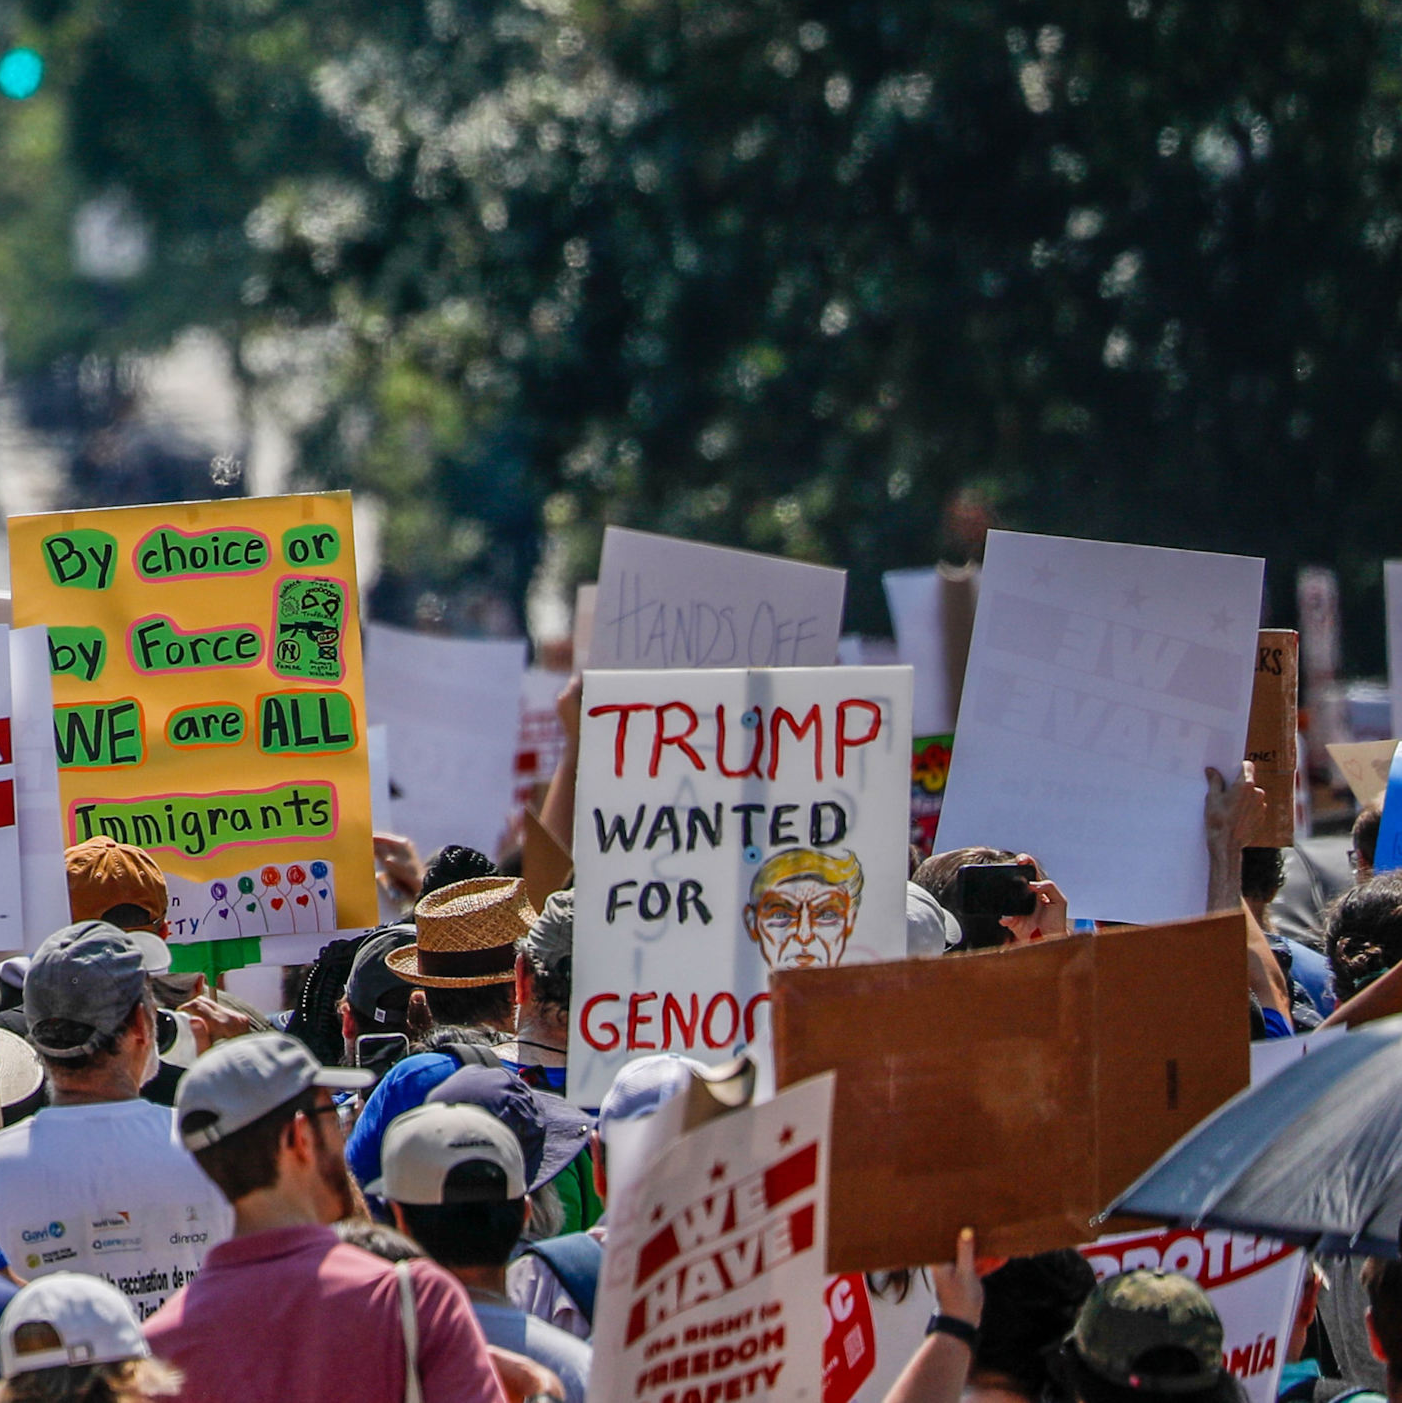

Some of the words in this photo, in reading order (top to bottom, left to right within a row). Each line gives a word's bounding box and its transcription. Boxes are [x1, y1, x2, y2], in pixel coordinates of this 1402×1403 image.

[46, 537, 112, 589] By
[142, 533, 263, 581] choice
[289, 533, 334, 563] or
[607, 570, 736, 667] HANDS
[749, 602, 816, 667] OFF
[47, 633, 101, 681] by
[138, 622, 256, 669] Force
[1255, 648, 1282, 675] RS
[54, 703, 136, 764] WE
[174, 712, 240, 741] are
[263, 698, 349, 748] ALL
[588, 698, 881, 782] TRUMP
[75, 790, 328, 854] Immigrants
[594, 801, 846, 853] WANTED
[606, 879, 712, 924] FOR
[672, 1171, 766, 1249] WE
[646, 1210, 794, 1327] HAVE
[684, 1308, 753, 1342] RIGHT
[636, 1323, 785, 1397] FREEDOM
